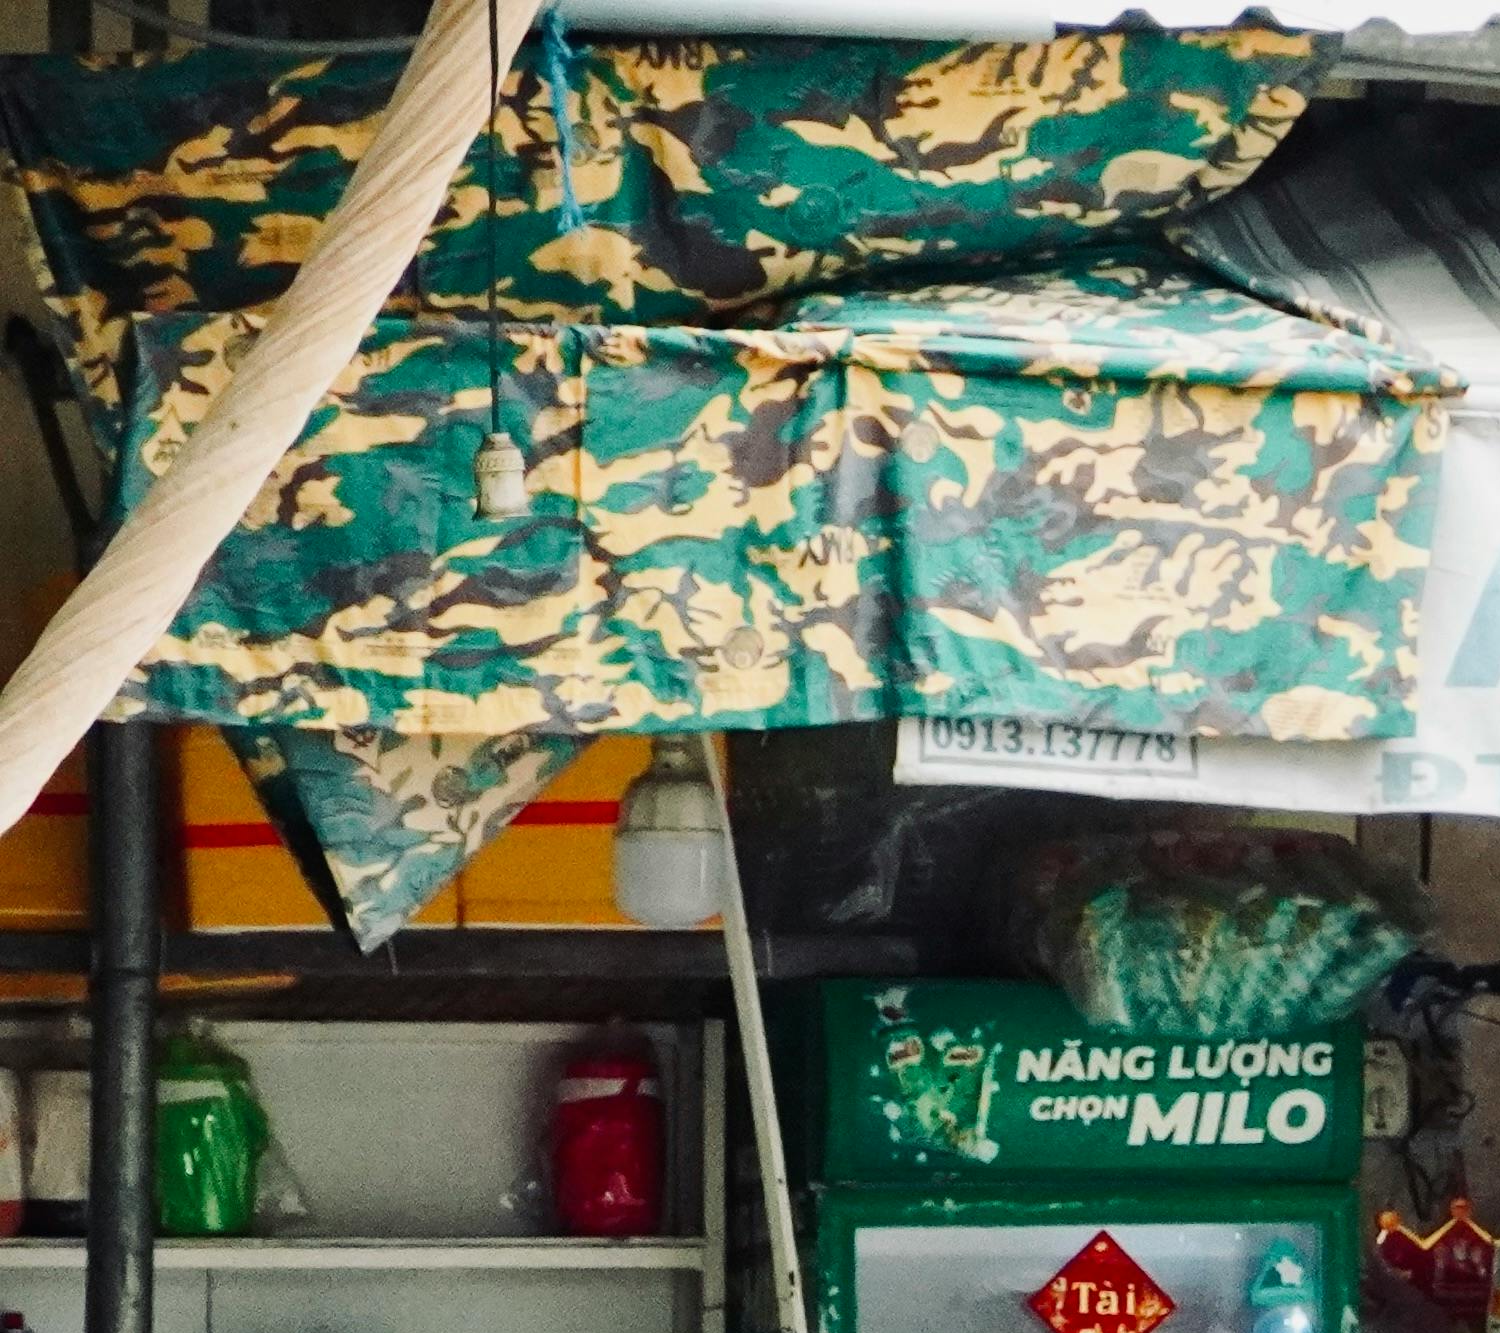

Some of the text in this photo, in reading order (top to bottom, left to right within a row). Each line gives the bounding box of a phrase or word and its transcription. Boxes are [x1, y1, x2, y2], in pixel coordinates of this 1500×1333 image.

[931, 715, 1176, 762] 0913.137778
[1016, 1039, 1334, 1088] NĂNG LƯỢNG
[1030, 1088, 1327, 1146] CHỌN MILO
[1071, 1277, 1138, 1317] Tài
